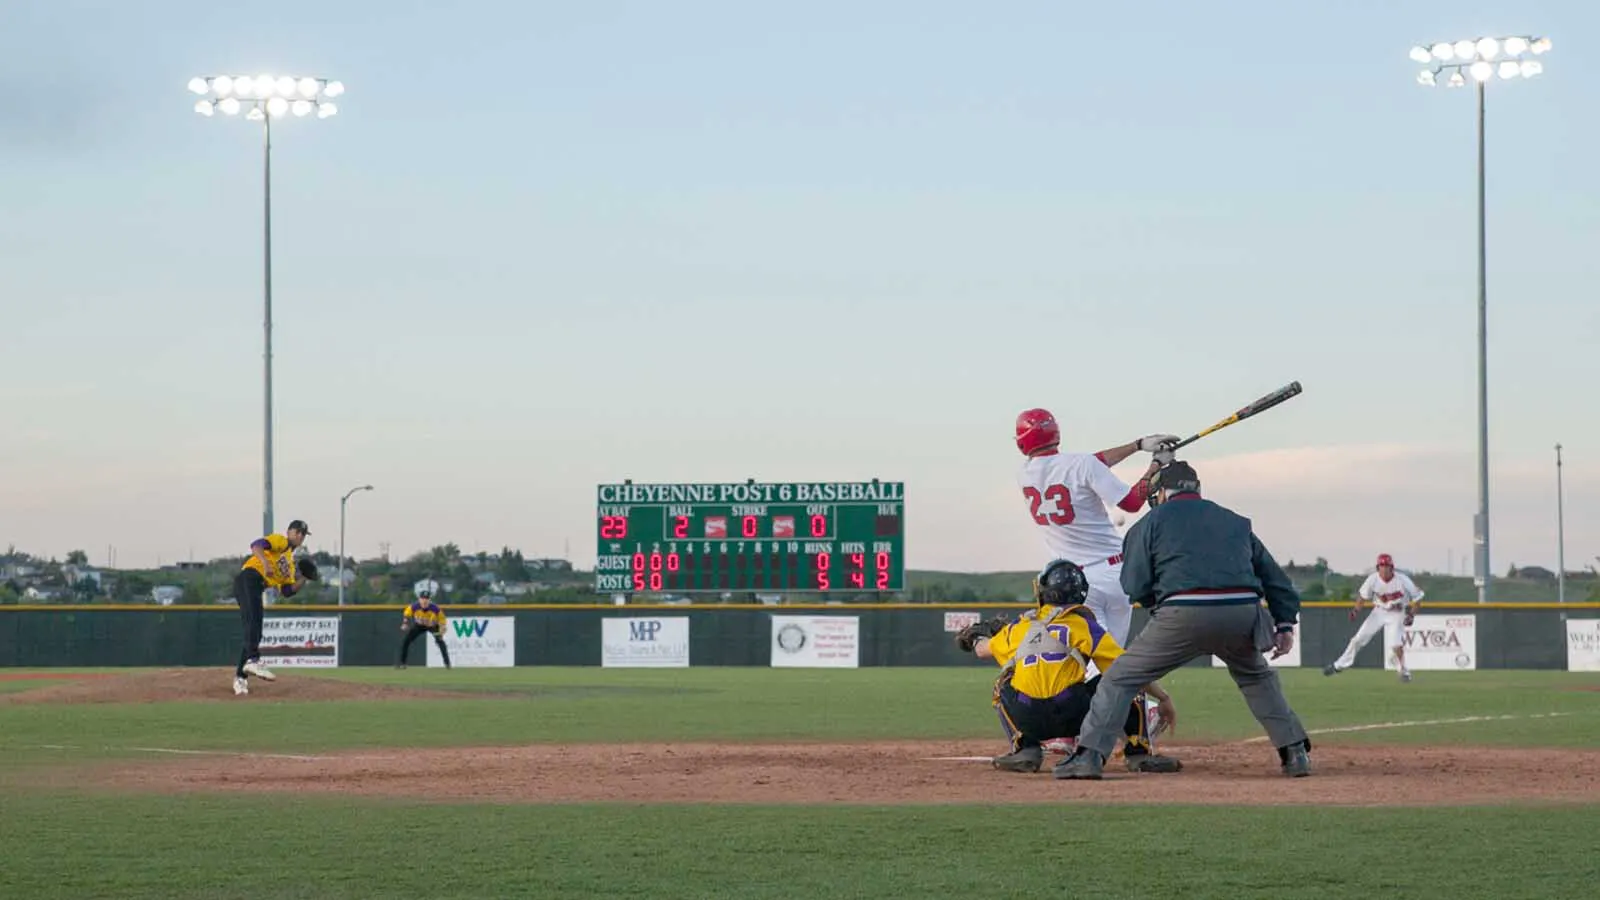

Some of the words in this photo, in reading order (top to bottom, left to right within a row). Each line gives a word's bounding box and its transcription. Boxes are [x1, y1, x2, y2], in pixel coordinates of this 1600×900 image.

[600, 484, 716, 502] CHEYENNE
[719, 484, 775, 502] POST
[779, 484, 792, 501] 6
[796, 483, 903, 501] BASEBALL
[669, 505, 694, 517] BALL
[732, 505, 767, 517] STRIKE
[806, 504, 828, 516] OUT
[1022, 483, 1076, 526] 23
[601, 515, 627, 538] 23
[674, 515, 689, 538] 2
[742, 515, 757, 538] 0
[811, 514, 826, 537] 0
[652, 542, 660, 553] 2
[669, 542, 677, 553] 3
[686, 542, 693, 553] 4
[703, 542, 711, 553] 5
[720, 542, 728, 553] 6
[737, 542, 745, 553] 7
[754, 542, 762, 553] 8
[771, 542, 779, 553] 9
[787, 542, 799, 553] 10
[804, 542, 832, 554] RUNS
[841, 542, 865, 554] HITS
[873, 542, 892, 553] ERR
[598, 555, 631, 569] GUEST
[633, 553, 645, 571] 0
[650, 553, 662, 571] 0
[667, 553, 679, 571] 0
[817, 552, 830, 570] 0
[851, 553, 864, 569] 4
[876, 552, 889, 570] 0
[598, 574, 622, 589] POST
[623, 574, 632, 588] 6
[633, 572, 645, 590] 5
[650, 572, 662, 590] 0
[817, 572, 830, 590] 5
[851, 573, 864, 589] 4
[876, 572, 889, 590] 2
[295, 621, 317, 629] POST
[452, 619, 489, 638] WV
[629, 620, 662, 641] MHP
[262, 633, 305, 645] heyenne
[309, 632, 336, 644] Light
